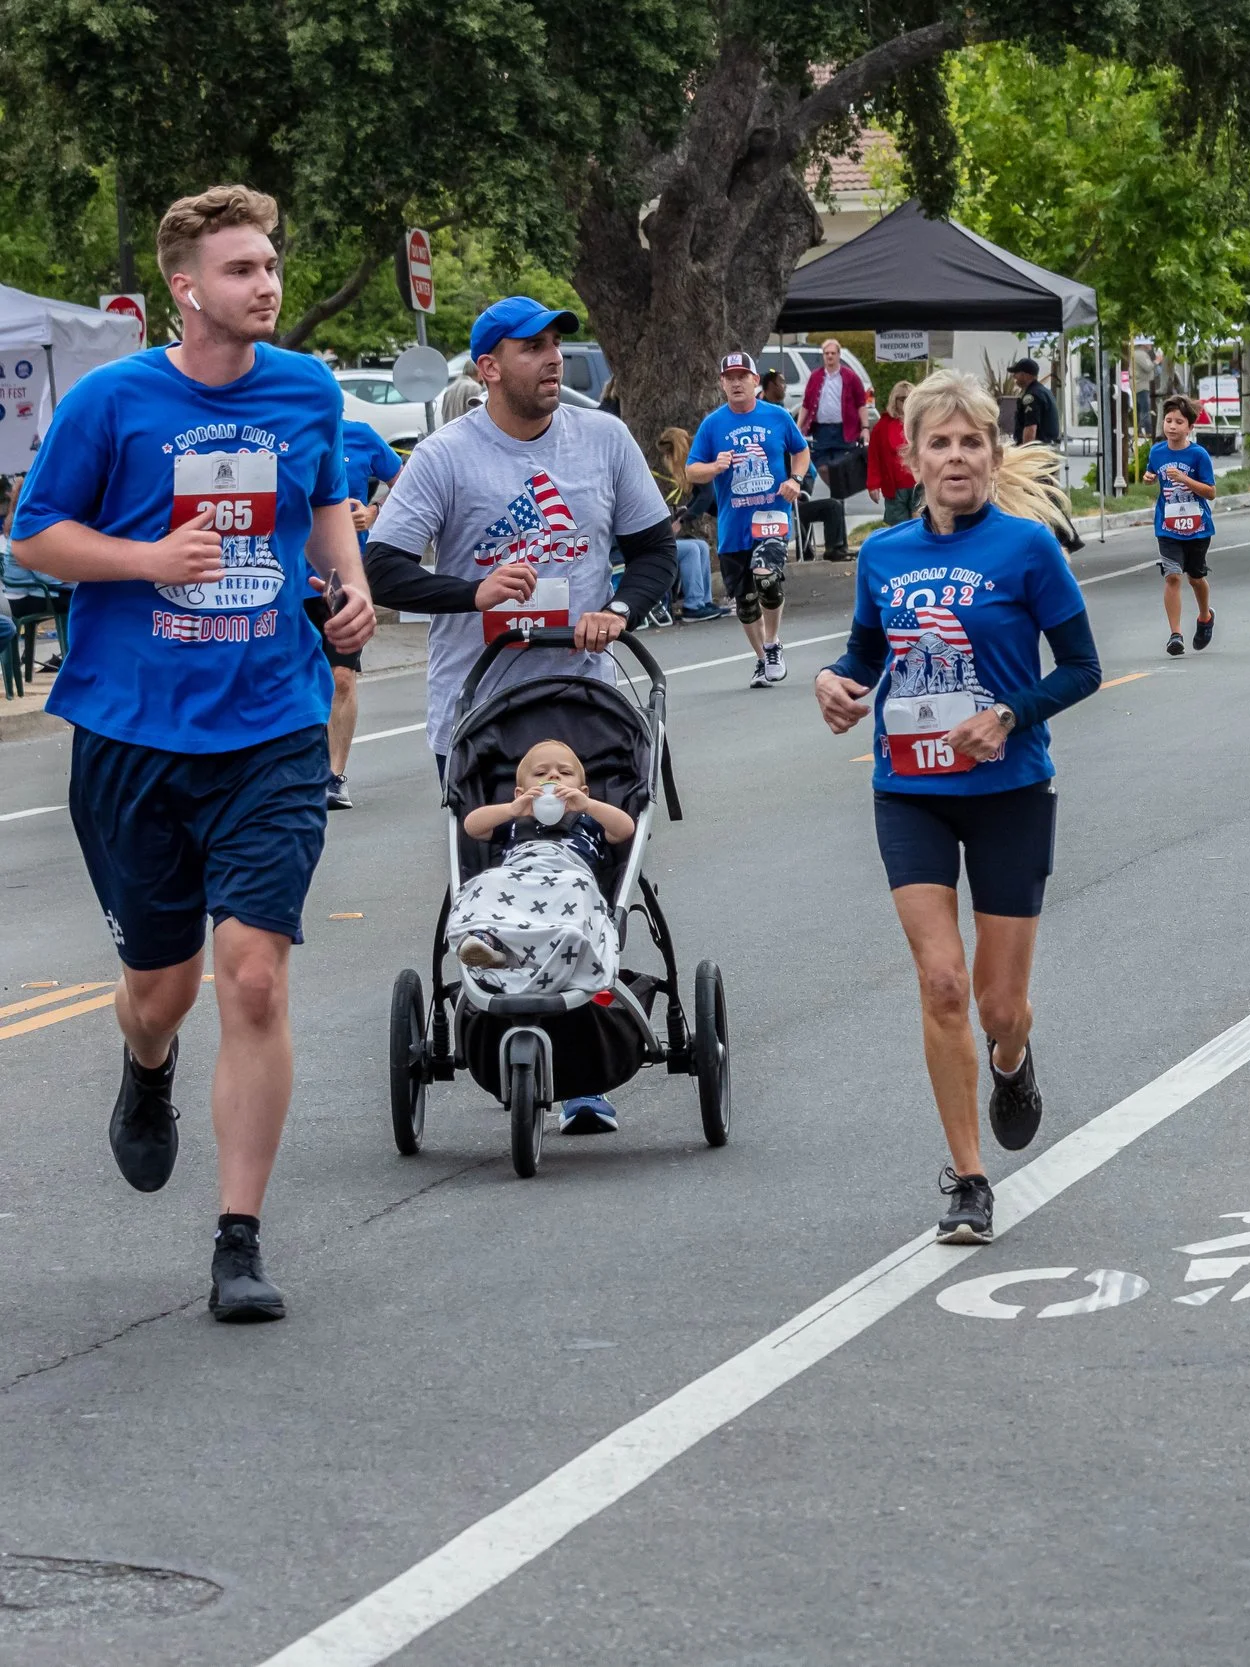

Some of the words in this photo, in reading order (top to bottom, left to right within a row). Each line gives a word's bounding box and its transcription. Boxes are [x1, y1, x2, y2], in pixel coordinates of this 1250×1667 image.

[416, 280, 430, 297] ENTER
[880, 332, 910, 340] RESERVED
[880, 342, 909, 350] FREEDOM
[910, 342, 924, 350] FEST
[8, 386, 27, 399] FEST
[174, 423, 237, 451] MORGAN
[240, 425, 277, 450] HILL
[761, 524, 780, 536] 512
[1174, 517, 1195, 530] 429
[473, 526, 590, 568] adidas
[217, 578, 279, 593] FREEDOM
[890, 567, 947, 590] MORGAN
[949, 567, 983, 588] HILL
[215, 594, 255, 606] RING!
[252, 608, 279, 638] EST
[911, 737, 955, 769] 175
